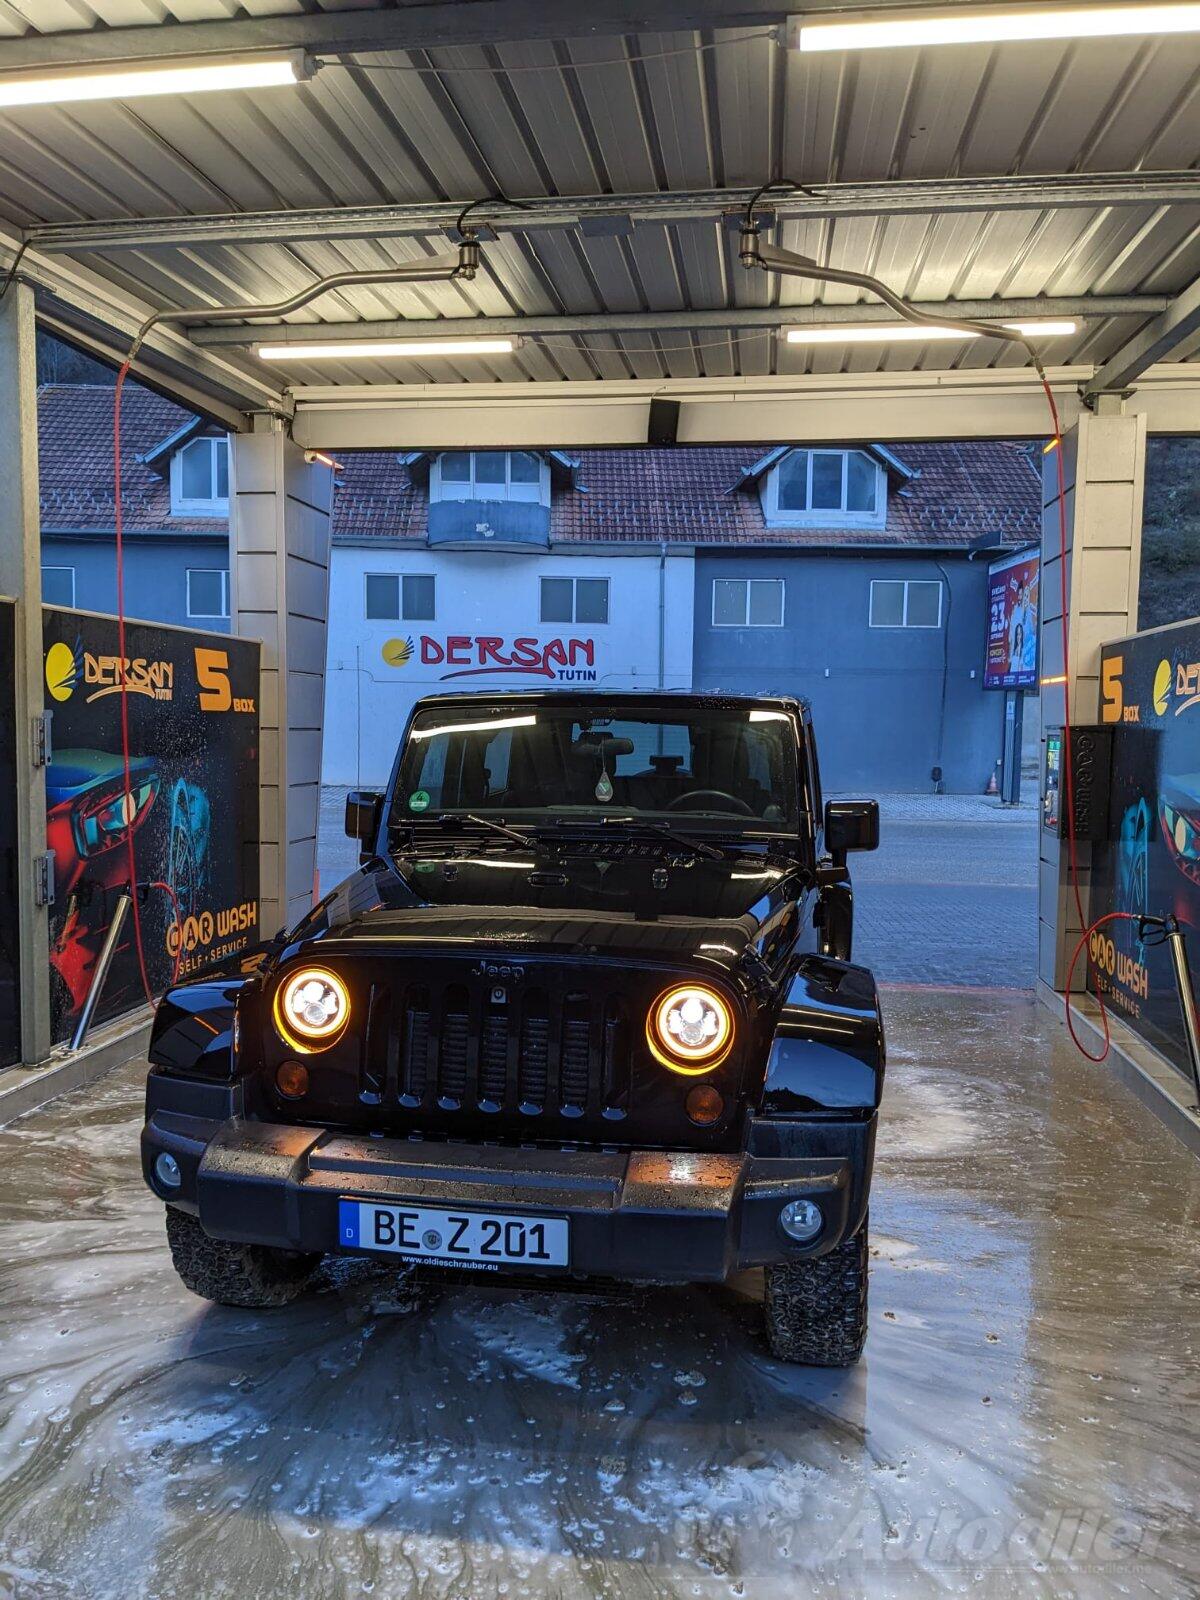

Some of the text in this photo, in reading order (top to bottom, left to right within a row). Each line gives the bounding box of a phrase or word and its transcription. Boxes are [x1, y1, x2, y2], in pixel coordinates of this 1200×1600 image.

[420, 636, 595, 668] DERSAN
[84, 651, 173, 689] DERSAN
[194, 648, 231, 711] 5
[557, 669, 597, 681] TUTIN
[1176, 662, 1200, 695] DE
[234, 698, 255, 713] BOX
[1102, 656, 1123, 722] 5
[1123, 705, 1140, 722] BOX
[166, 901, 257, 957] CAR WASH
[179, 937, 247, 975] SELF SERVICE
[471, 960, 525, 985] Jeep
[1089, 929, 1148, 1000] CAR WASH
[1112, 986, 1140, 1019] SERVICE
[345, 1228, 354, 1238] D
[374, 1210, 550, 1260] BE Z 201
[402, 1255, 499, 1271] www.oldieschrauber.eu
